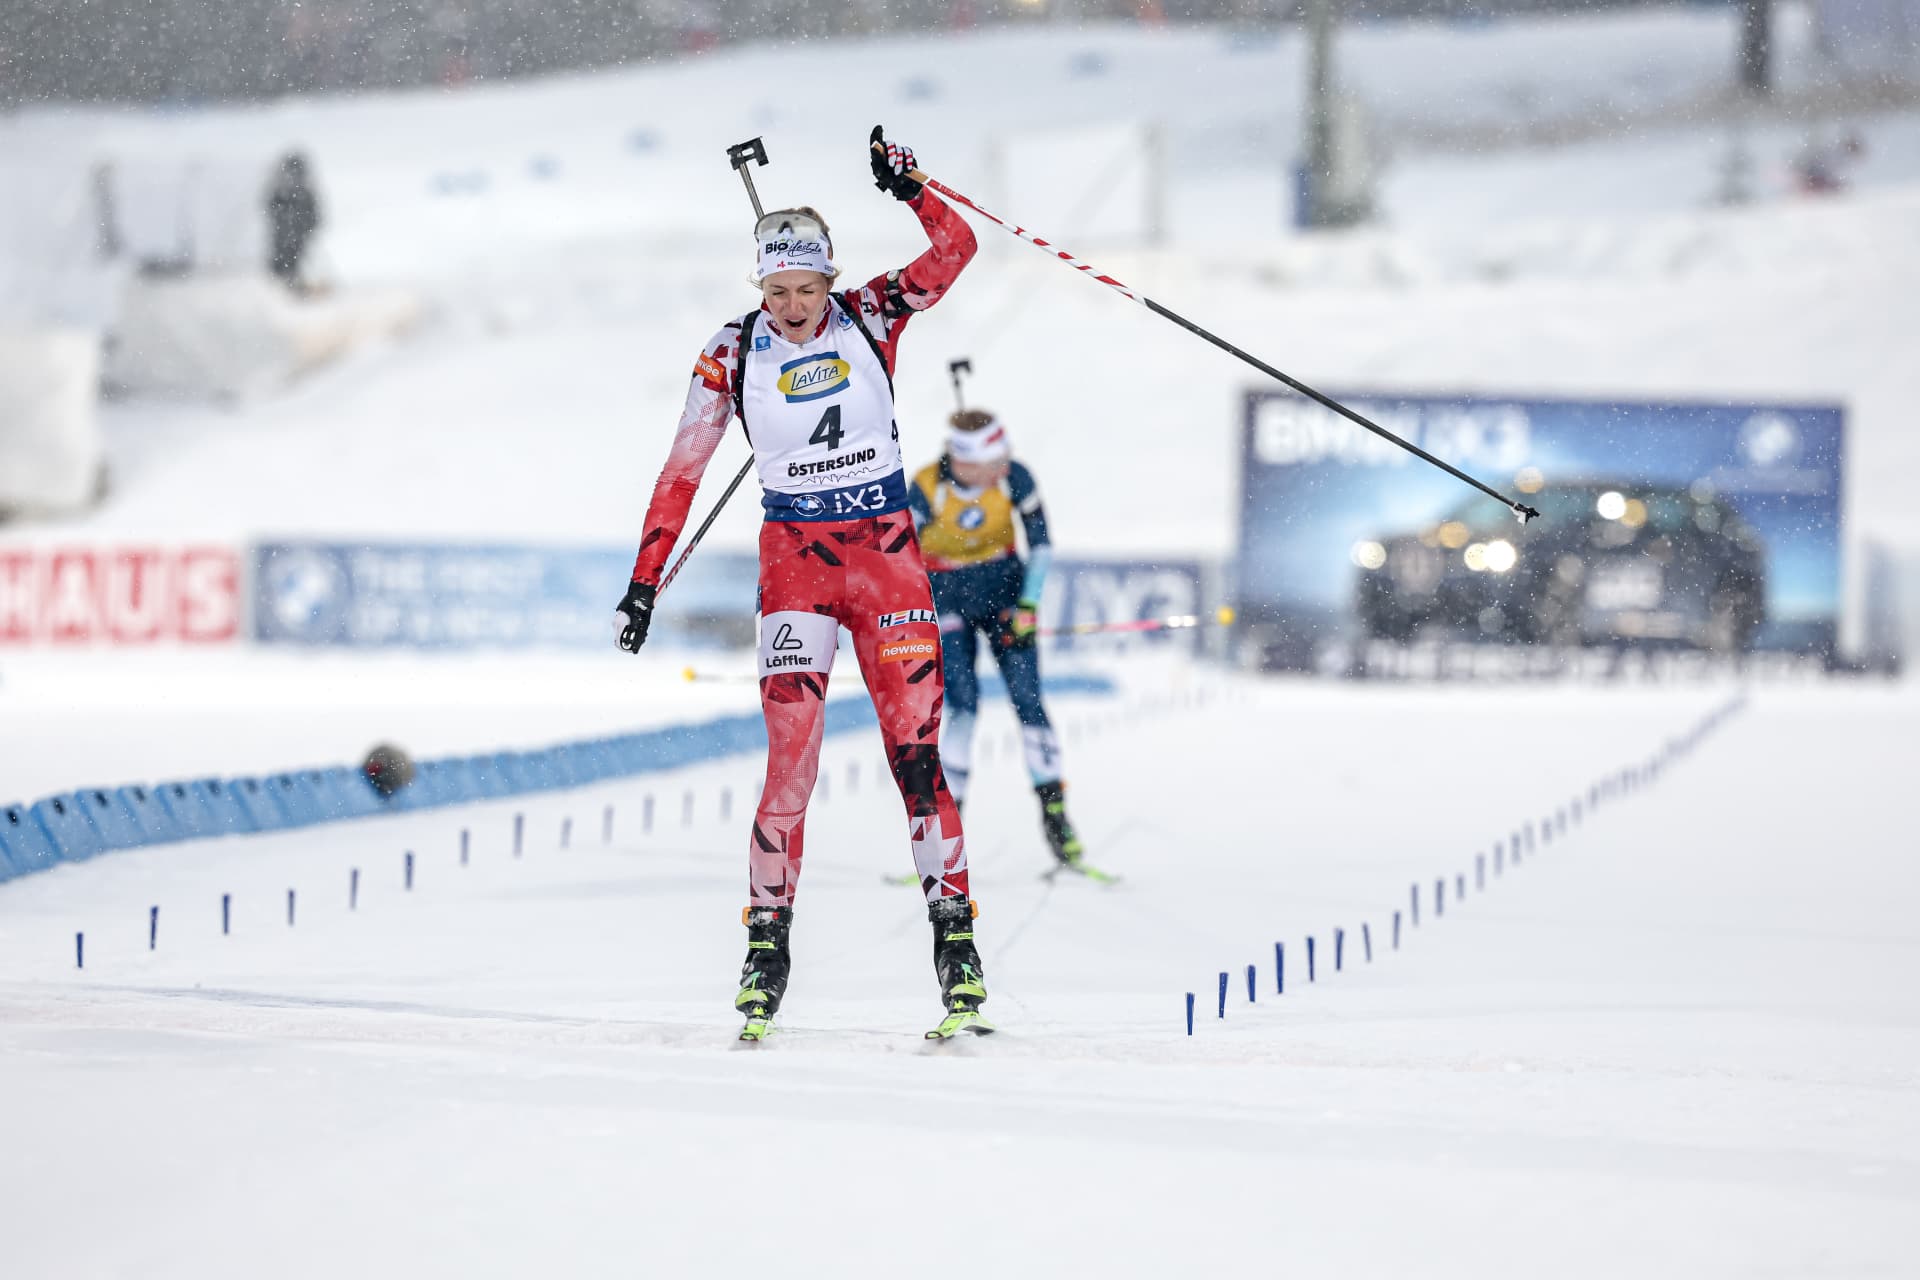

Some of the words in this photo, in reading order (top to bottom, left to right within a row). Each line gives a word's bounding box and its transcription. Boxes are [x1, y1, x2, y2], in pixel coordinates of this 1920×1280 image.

[808, 404, 845, 452] 4
[787, 447, 876, 478] ÖSTERSUND
[834, 484, 887, 514] iX3
[0, 549, 239, 640] HAUS
[880, 610, 937, 627] HELLA
[766, 654, 813, 668] Löffler
[882, 644, 933, 657] newkee
